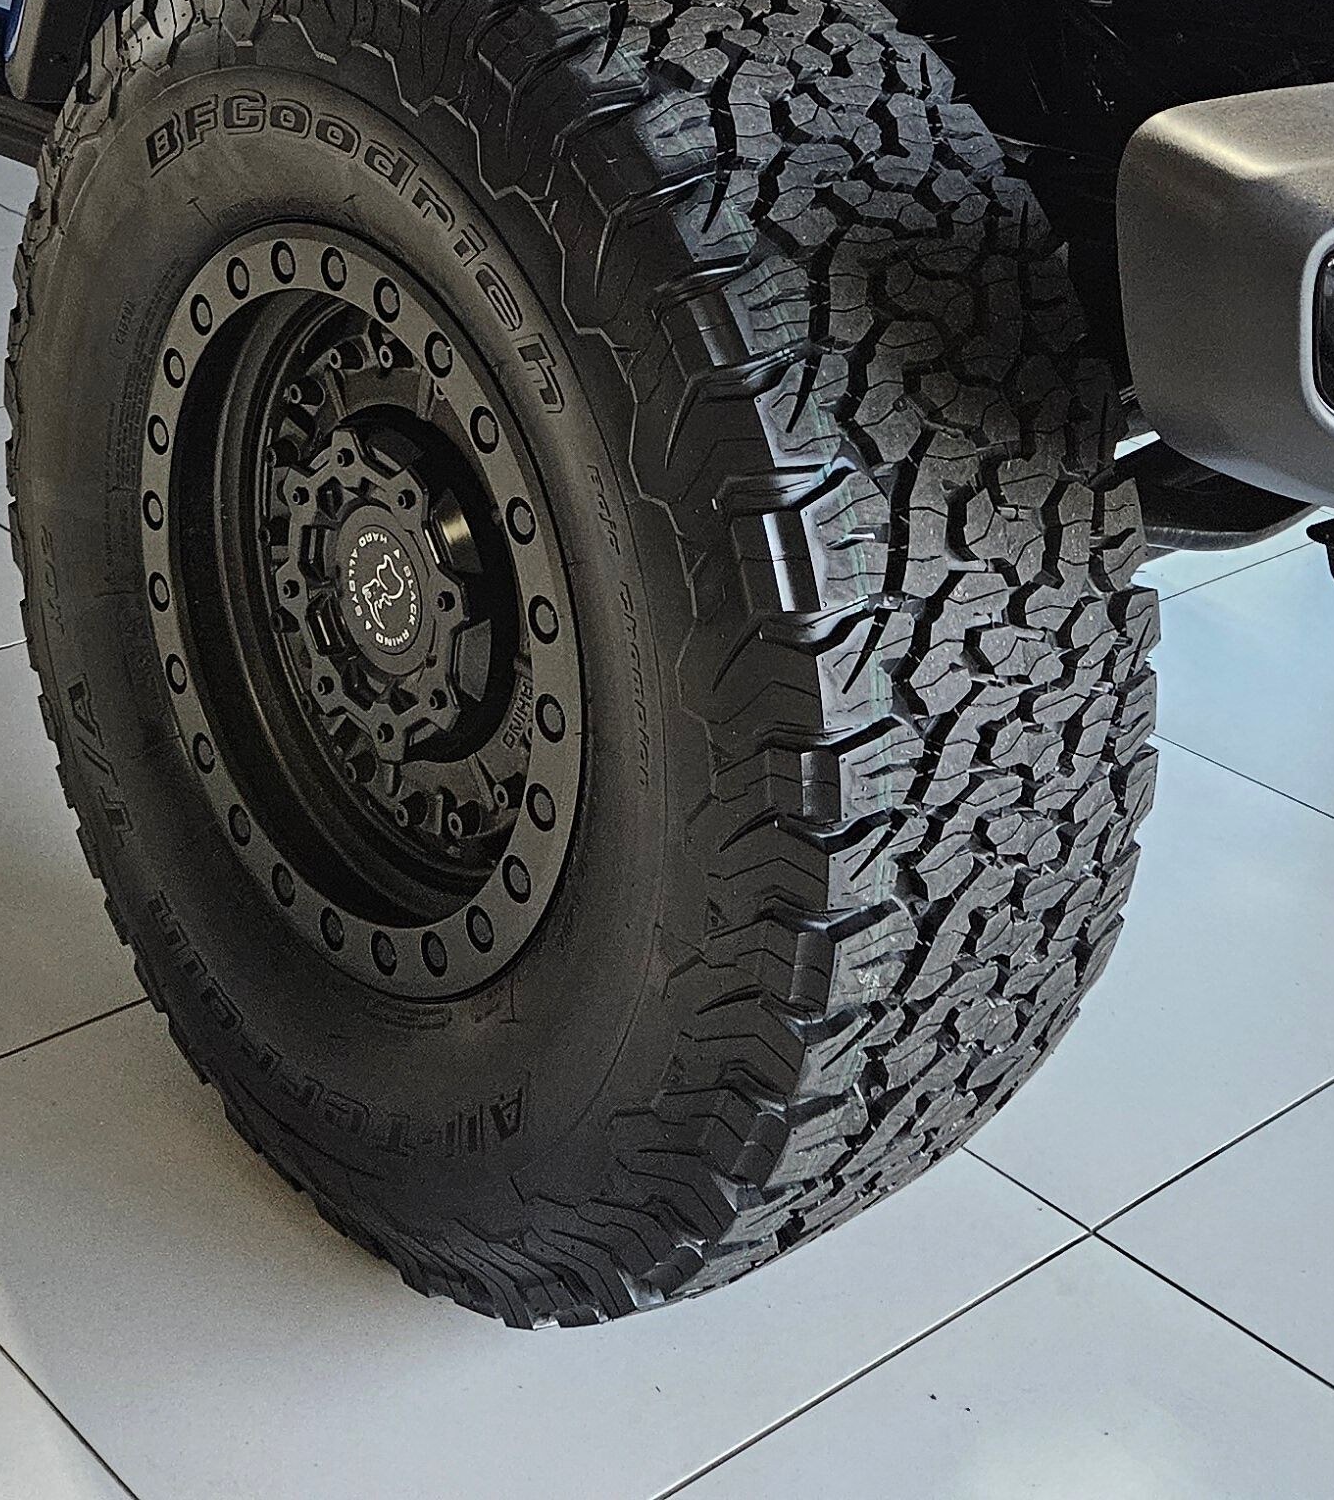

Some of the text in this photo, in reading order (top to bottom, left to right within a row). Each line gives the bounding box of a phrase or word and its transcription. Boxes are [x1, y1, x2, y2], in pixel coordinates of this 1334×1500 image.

[145, 88, 568, 415] BFGoodrich
[347, 531, 389, 617] HARD ALLOYS
[375, 564, 418, 647] BLACK RHINO
[67, 672, 134, 849] T/A
